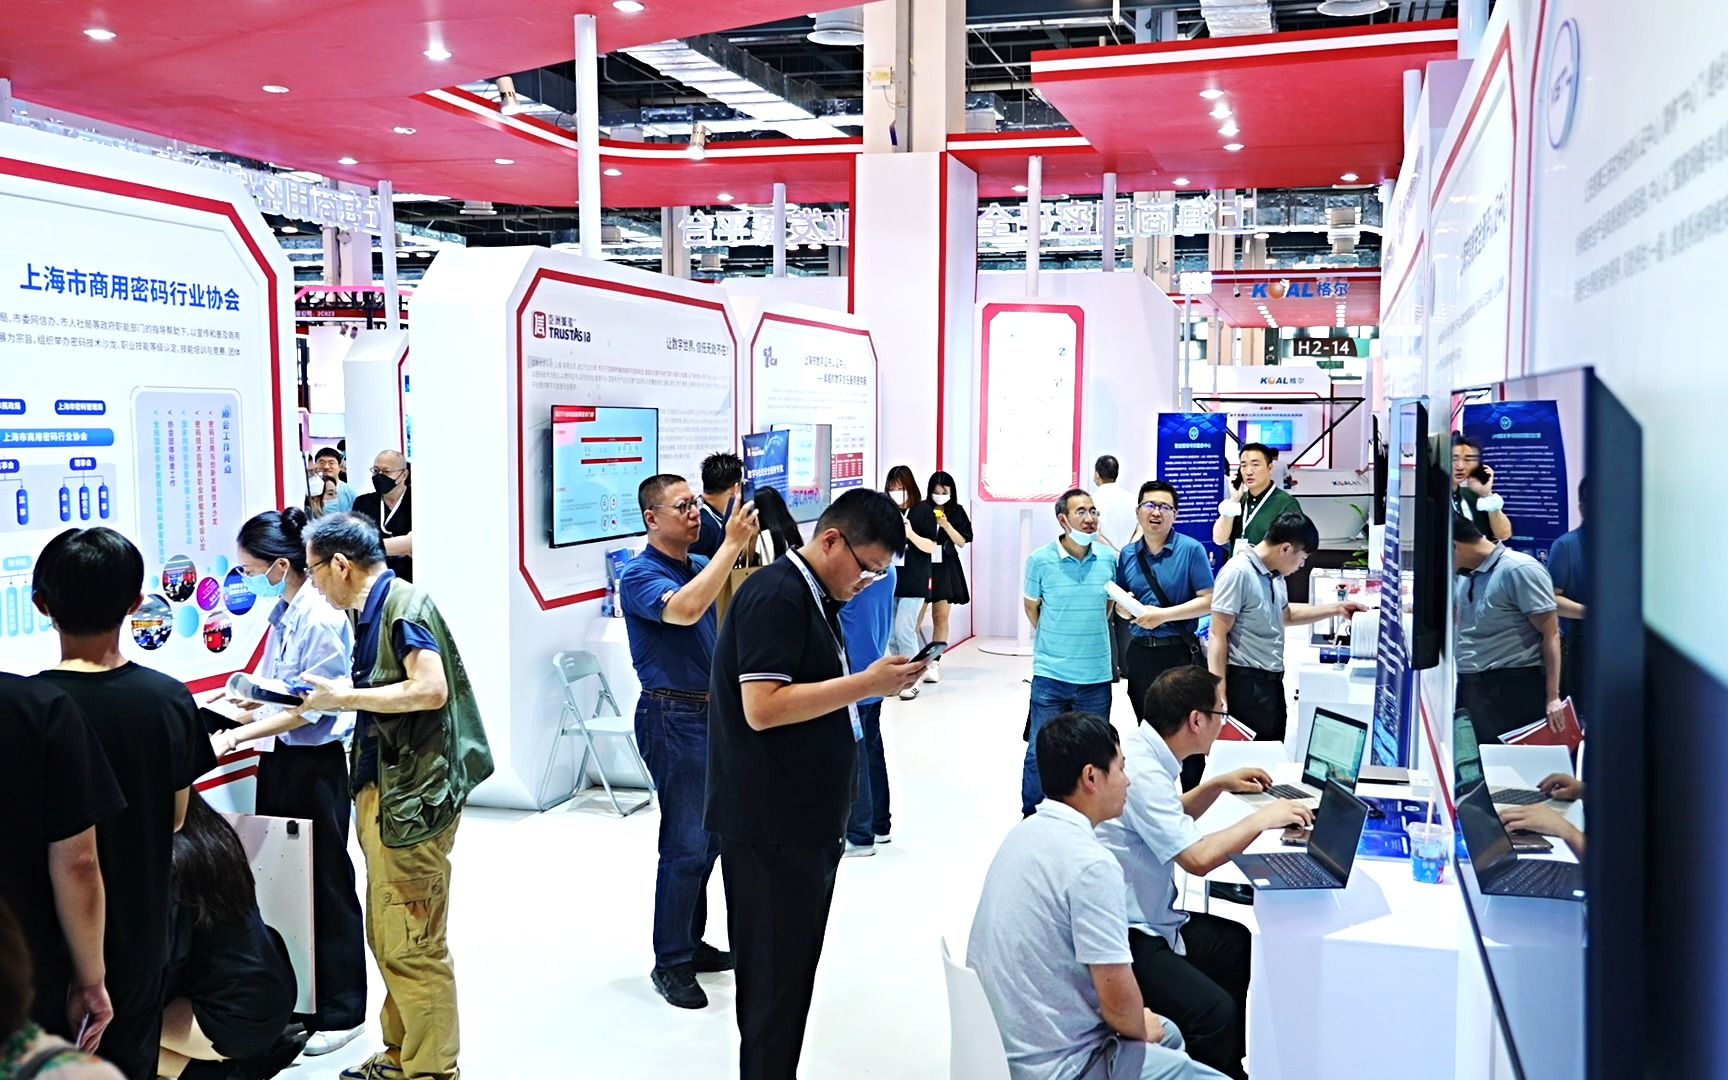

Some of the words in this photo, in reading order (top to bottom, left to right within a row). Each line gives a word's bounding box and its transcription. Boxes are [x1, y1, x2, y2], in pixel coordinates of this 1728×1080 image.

[19, 263, 240, 311] 上海市商用密码行业协会
[1317, 281, 1349, 297] 格尔
[1298, 341, 1349, 354] H2-14
[1260, 377, 1288, 385] KOAL
